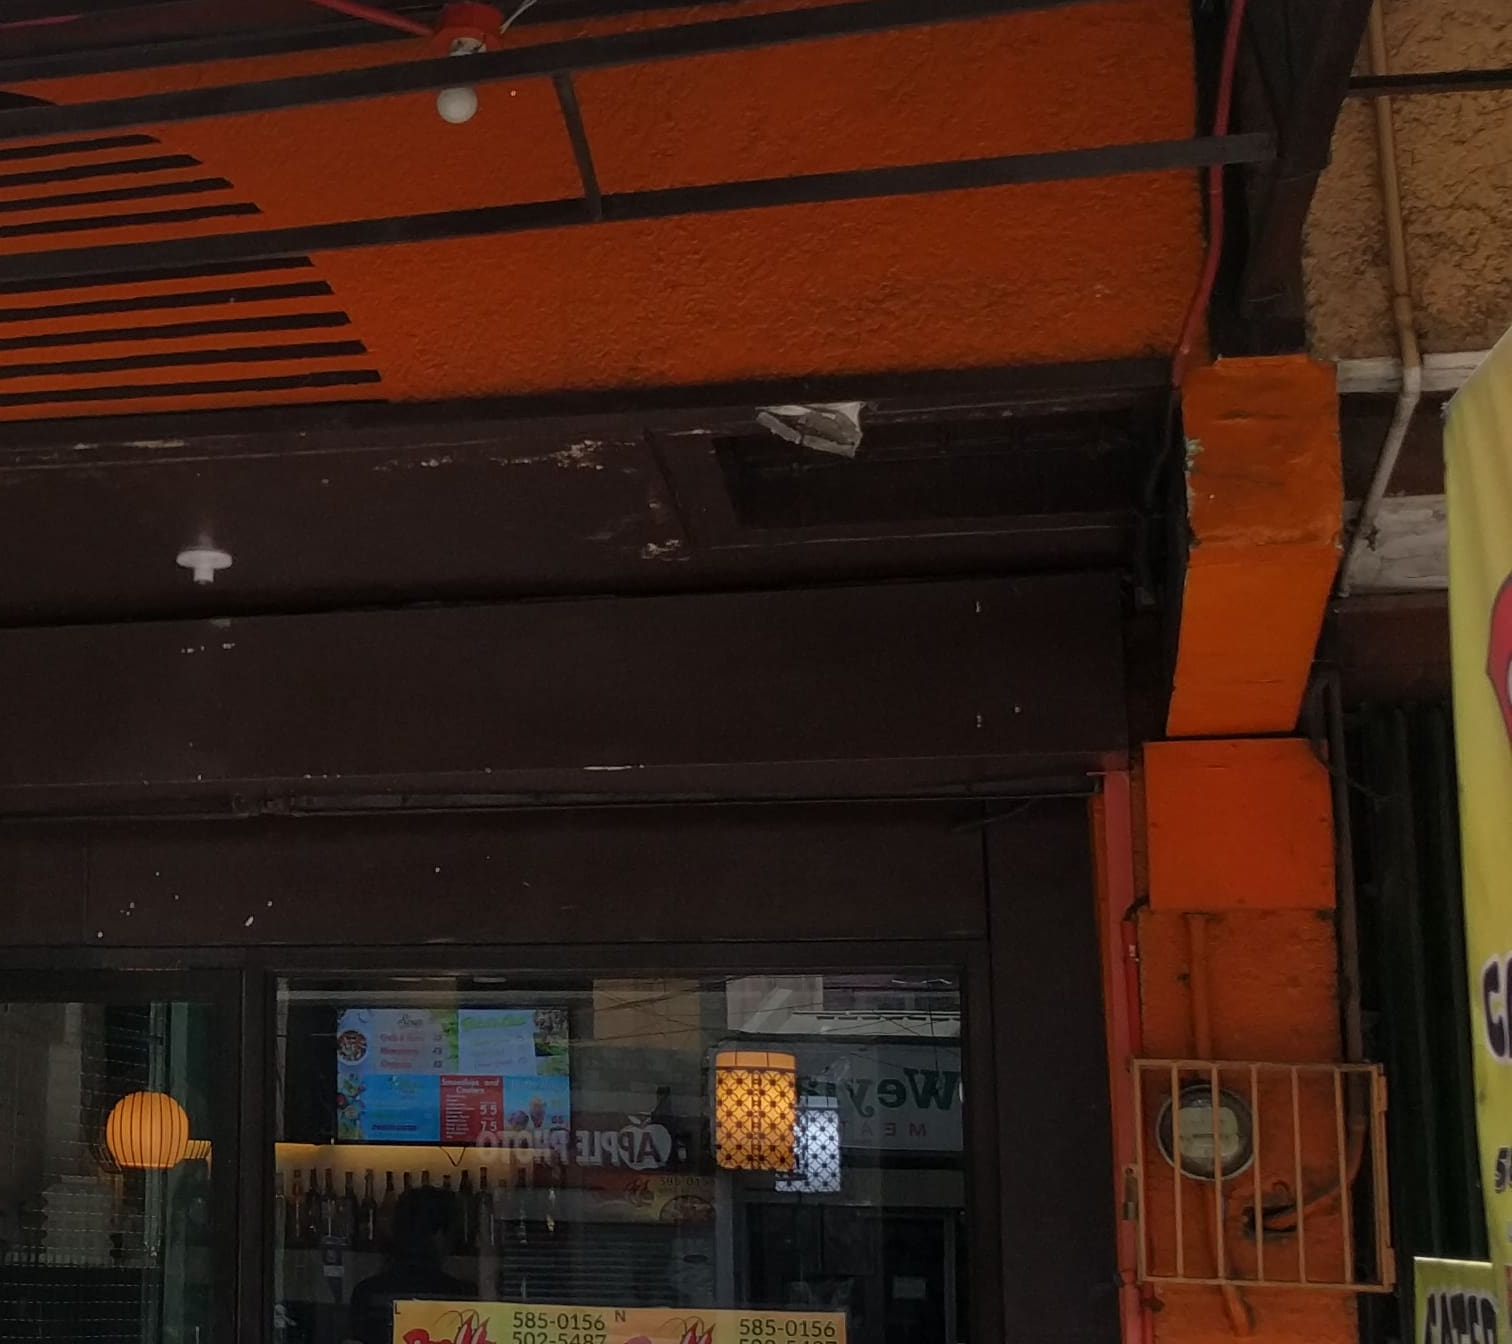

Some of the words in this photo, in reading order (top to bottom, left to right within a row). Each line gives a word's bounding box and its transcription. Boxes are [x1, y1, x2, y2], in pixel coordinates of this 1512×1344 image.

[513, 1312, 606, 1331] 585-0156
[615, 1311, 626, 1323] N
[739, 1319, 836, 1337] 585-0156
